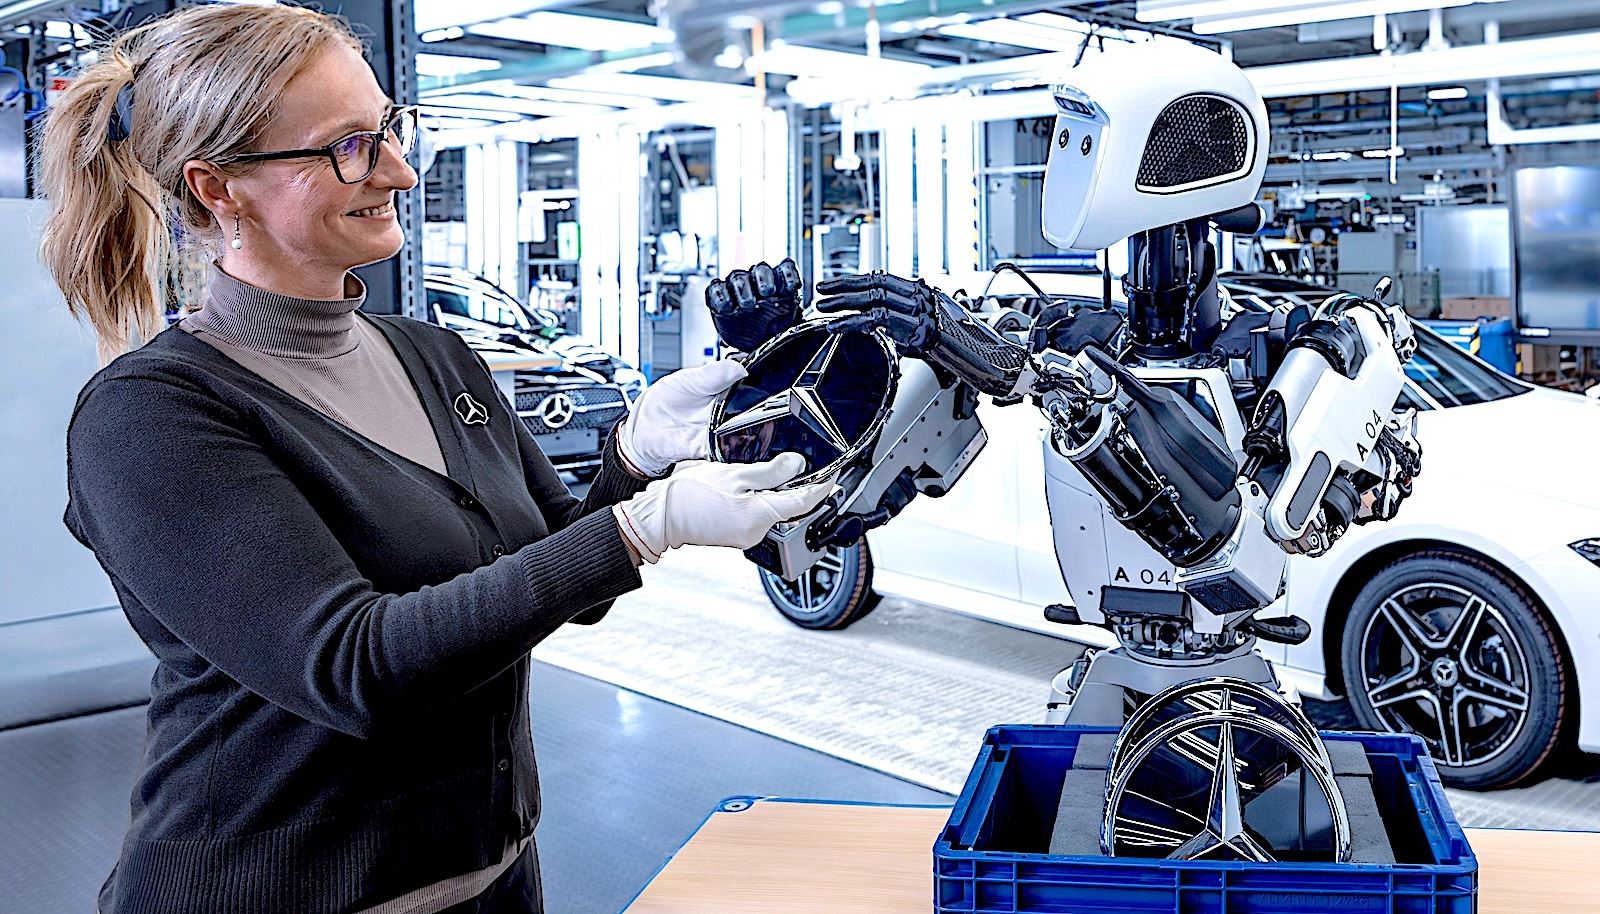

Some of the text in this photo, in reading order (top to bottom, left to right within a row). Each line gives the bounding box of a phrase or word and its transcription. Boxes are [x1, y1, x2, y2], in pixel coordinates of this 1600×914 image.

[1356, 409, 1382, 462] A 04
[1114, 566, 1171, 586] A 04
